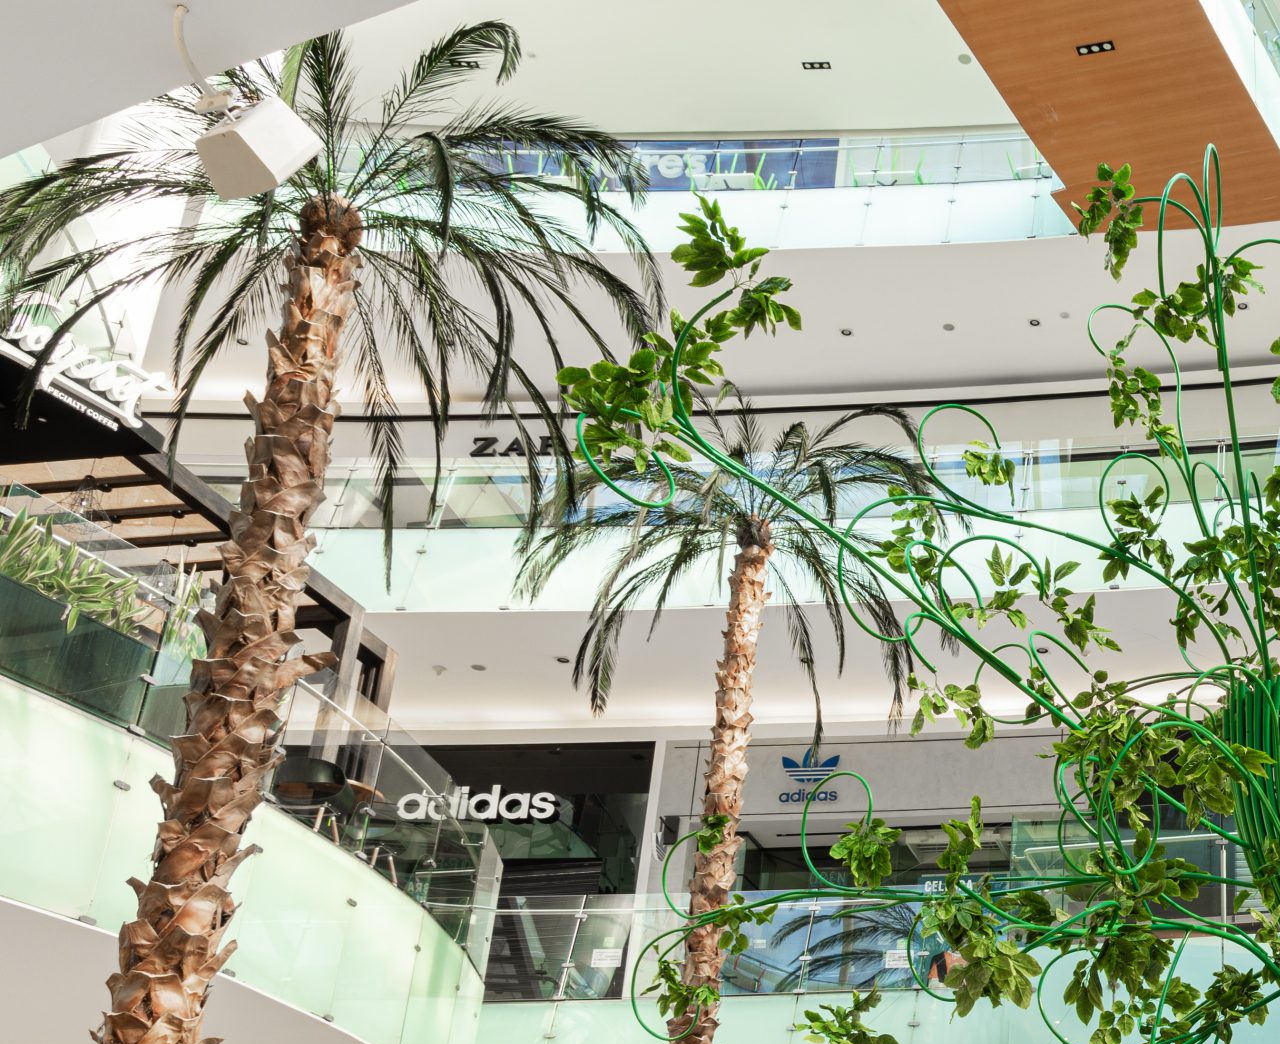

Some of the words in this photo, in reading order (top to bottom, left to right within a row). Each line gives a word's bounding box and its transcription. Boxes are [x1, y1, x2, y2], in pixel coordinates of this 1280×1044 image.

[46, 385, 87, 414] PECIALTY
[86, 408, 119, 432] COFFEE
[469, 436, 554, 457] ZAR
[397, 785, 557, 820] adidas
[778, 788, 838, 803] adidas
